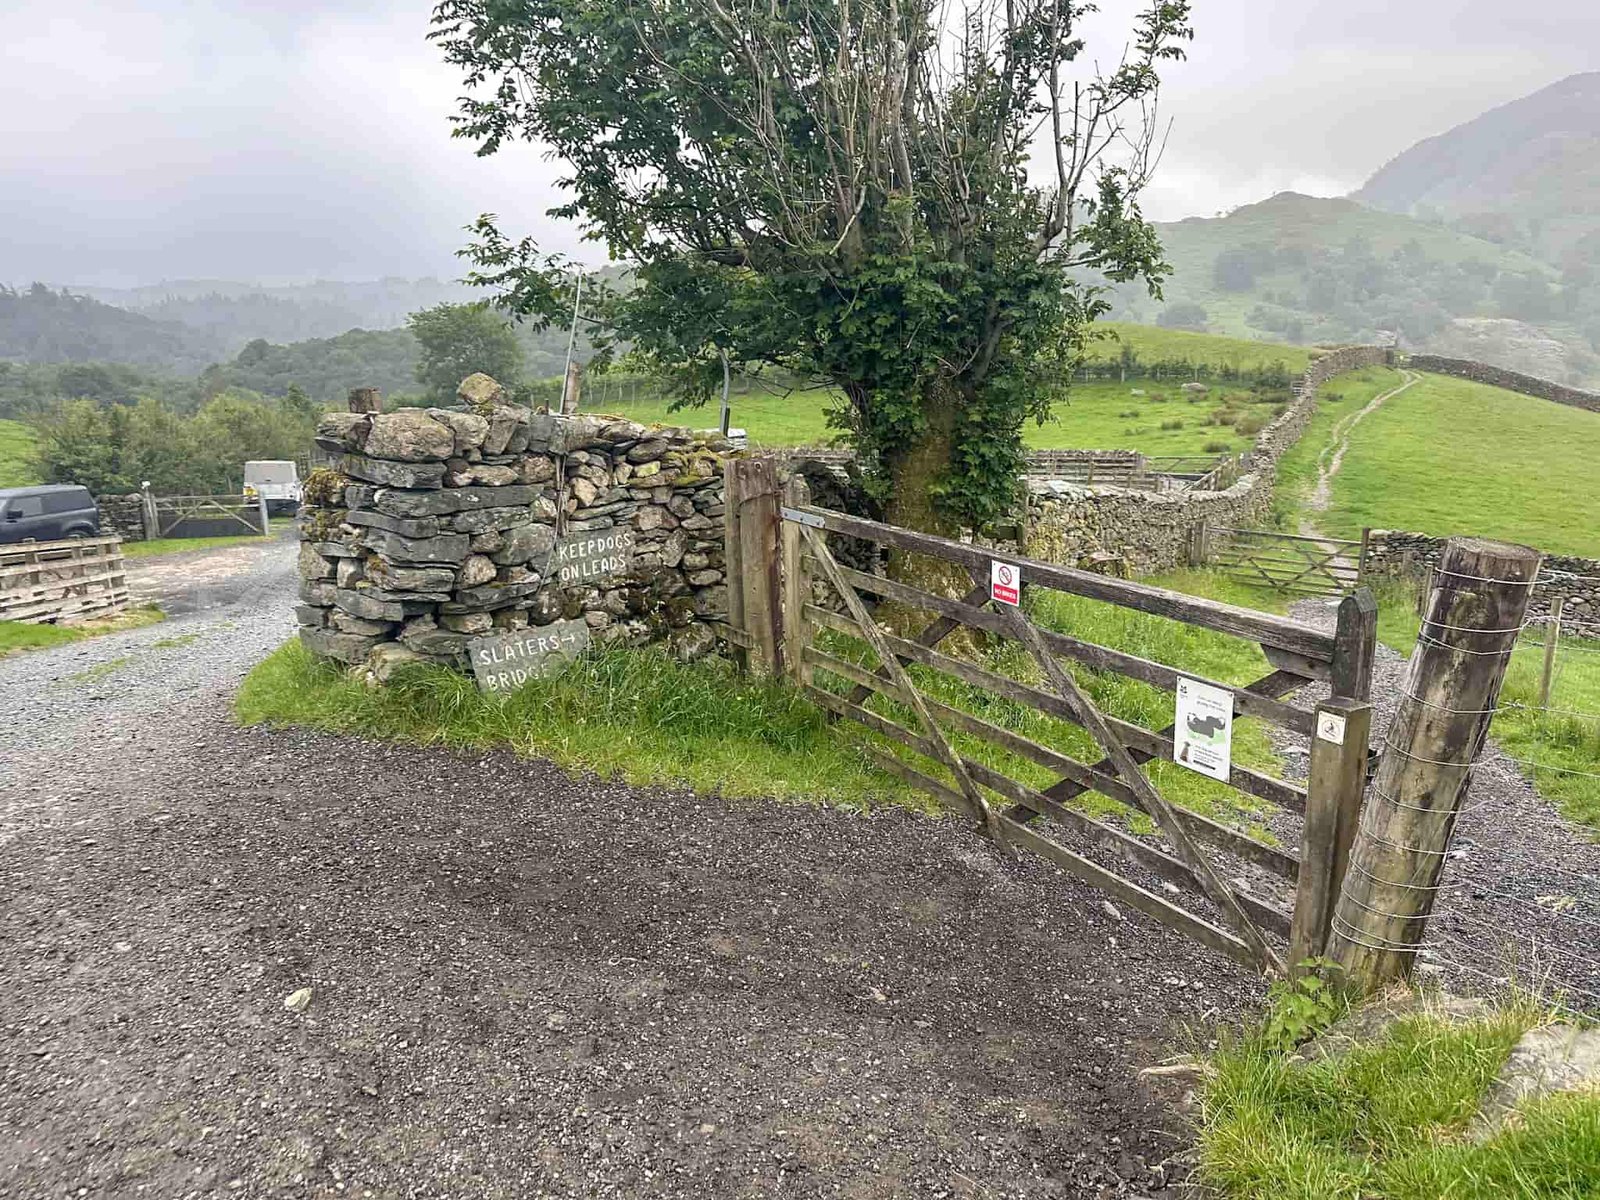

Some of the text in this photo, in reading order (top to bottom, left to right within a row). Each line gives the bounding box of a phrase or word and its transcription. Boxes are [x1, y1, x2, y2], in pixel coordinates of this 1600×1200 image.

[561, 554, 626, 581] ON LEADS
[479, 635, 560, 666] SLATERS
